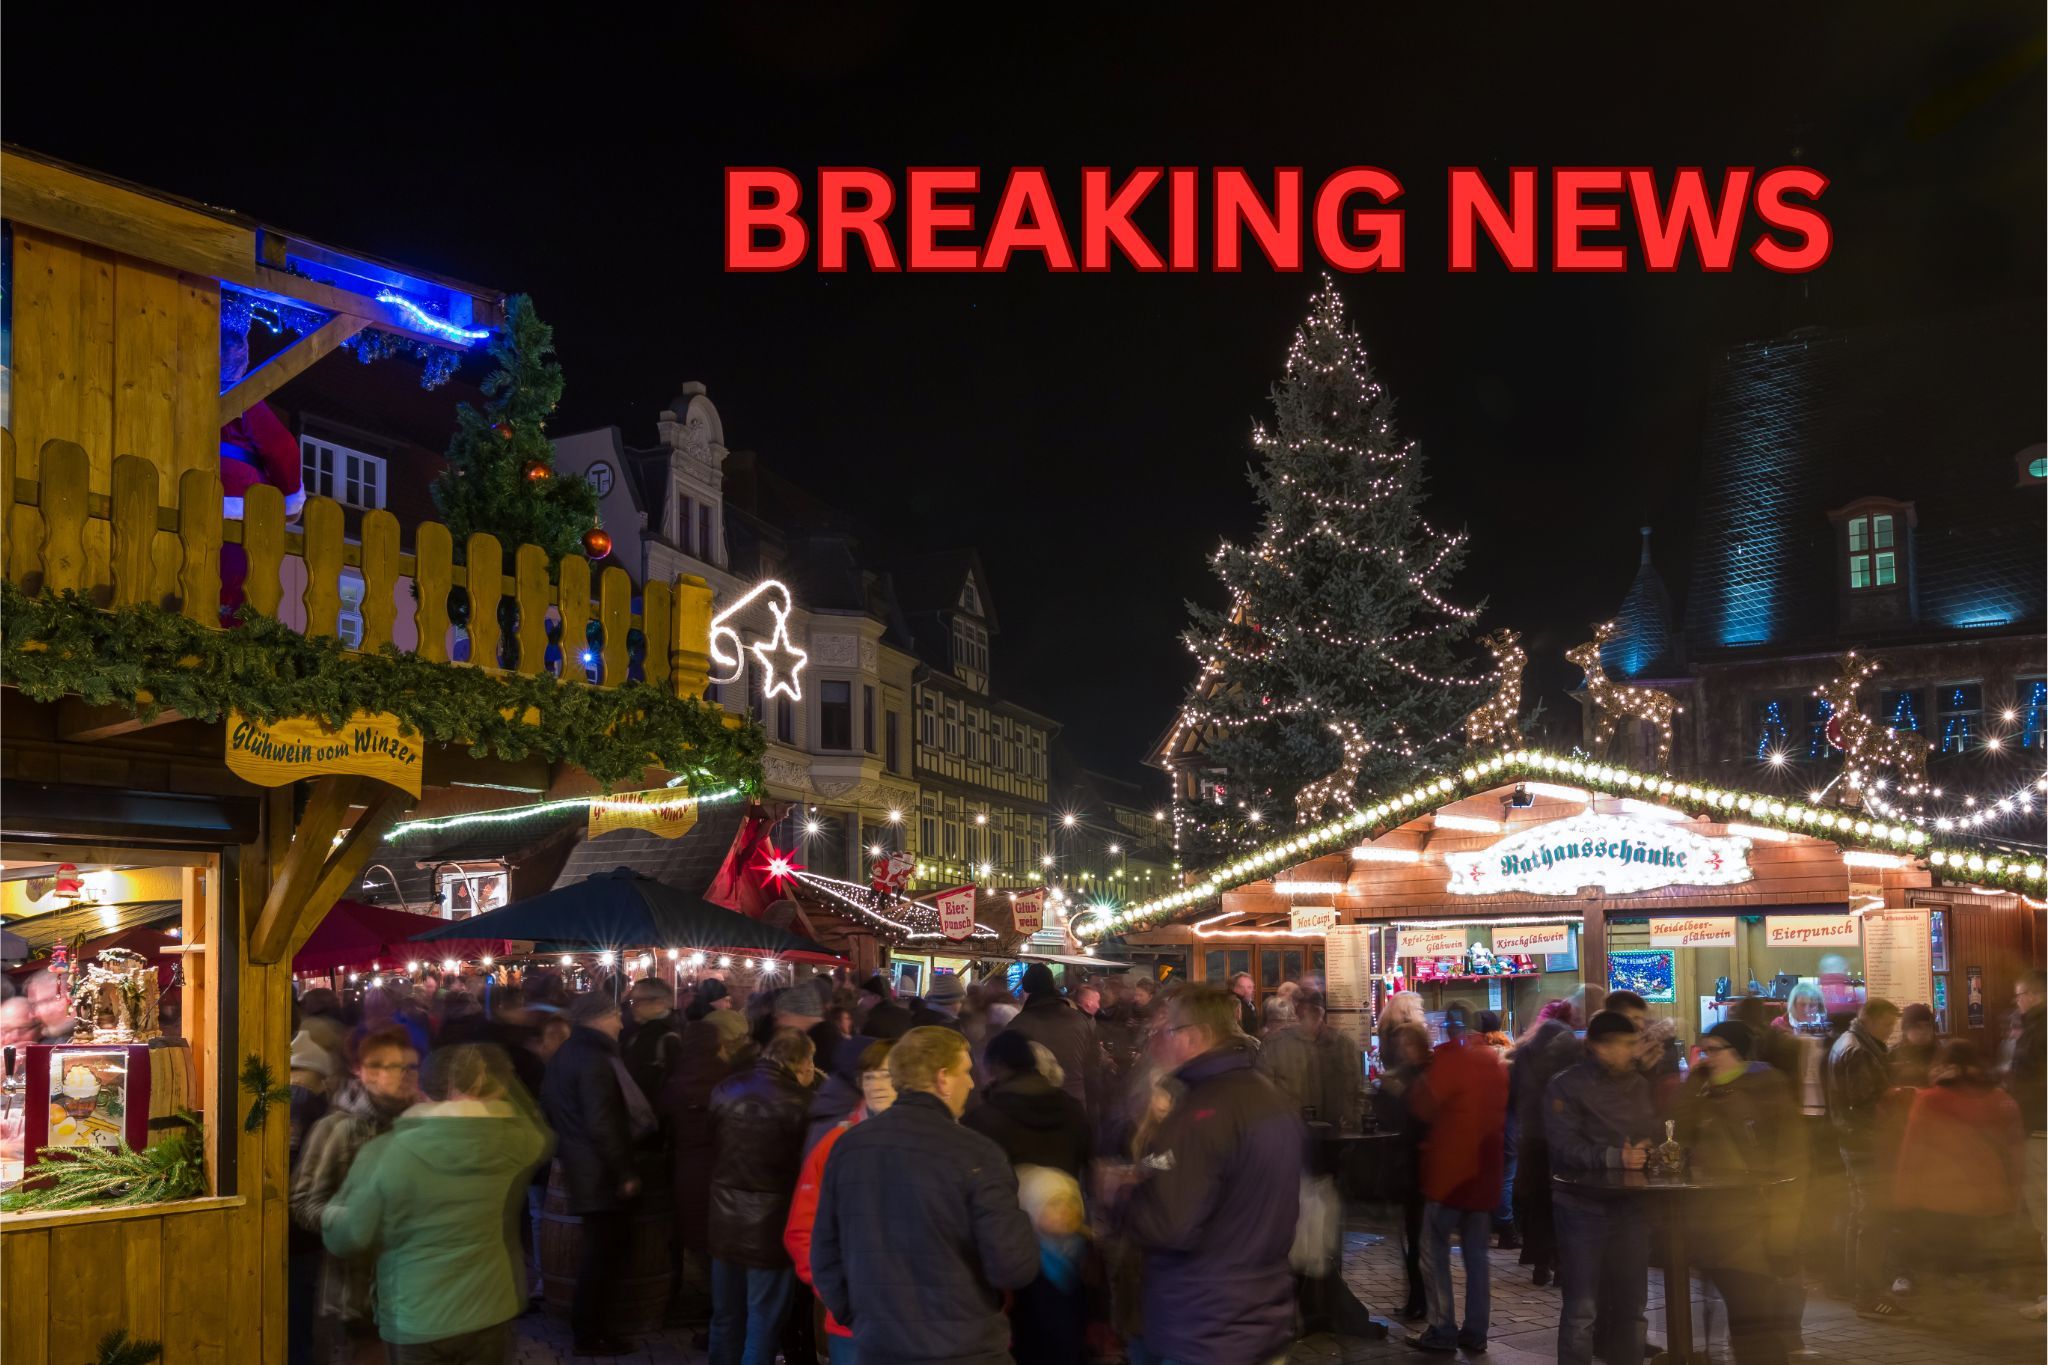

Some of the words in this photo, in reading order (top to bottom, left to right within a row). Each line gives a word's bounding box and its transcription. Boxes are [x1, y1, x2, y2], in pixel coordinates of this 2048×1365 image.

[232, 721, 312, 763] Glühwein
[317, 743, 350, 762] vom
[354, 727, 416, 765] Winzer
[1501, 837, 1687, 877] Rathausschänke
[945, 901, 969, 915] Eier-
[1015, 902, 1040, 914] Glüh-
[944, 917, 971, 932] punsch
[1019, 915, 1038, 927] wein
[1298, 917, 1311, 928] Hot
[1312, 912, 1331, 926] Caipi
[1654, 921, 1713, 934] Heidelbeer-
[1682, 929, 1731, 945] glühwein
[1772, 920, 1853, 941] Eierpunsch
[1426, 940, 1463, 953] Glühwein
[1496, 931, 1564, 949] Kirschglühwein
